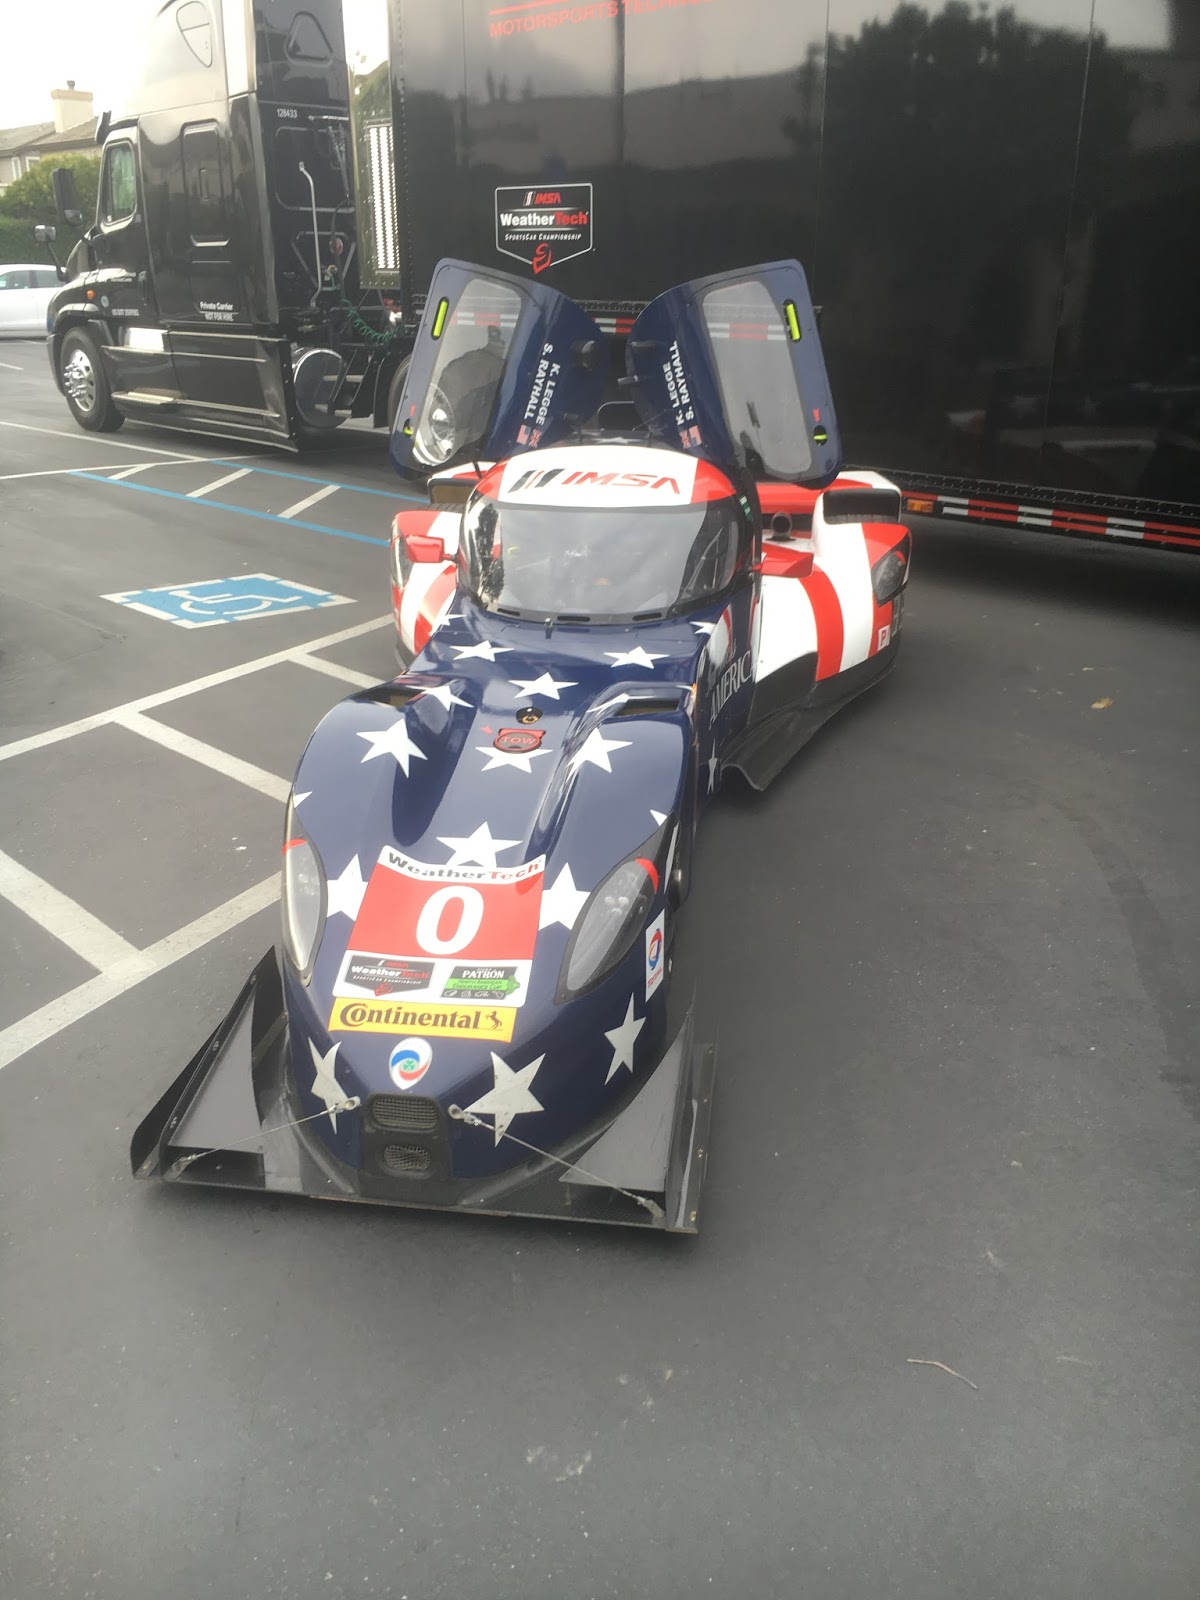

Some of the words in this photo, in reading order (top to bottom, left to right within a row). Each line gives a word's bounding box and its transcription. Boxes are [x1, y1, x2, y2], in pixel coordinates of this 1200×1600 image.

[490, 1, 619, 37] MOTORSPORTS
[500, 211, 588, 226] WeatherTech
[200, 302, 216, 310] Private
[216, 302, 233, 311] Carrier
[542, 343, 553, 356] S.
[549, 363, 561, 377] K.
[669, 340, 690, 405] RAYHALL
[524, 359, 550, 420] RAYHALL
[663, 361, 680, 409] LEGGE
[535, 380, 556, 426] LEGGE
[685, 405, 694, 421] S.
[676, 409, 685, 426] K.
[561, 471, 681, 495] IMSA
[502, 736, 536, 745] TOW
[388, 851, 541, 881] WeatherTech
[416, 885, 485, 956] 0
[351, 965, 429, 979] WeatherTech
[339, 1003, 481, 1030] Continental
